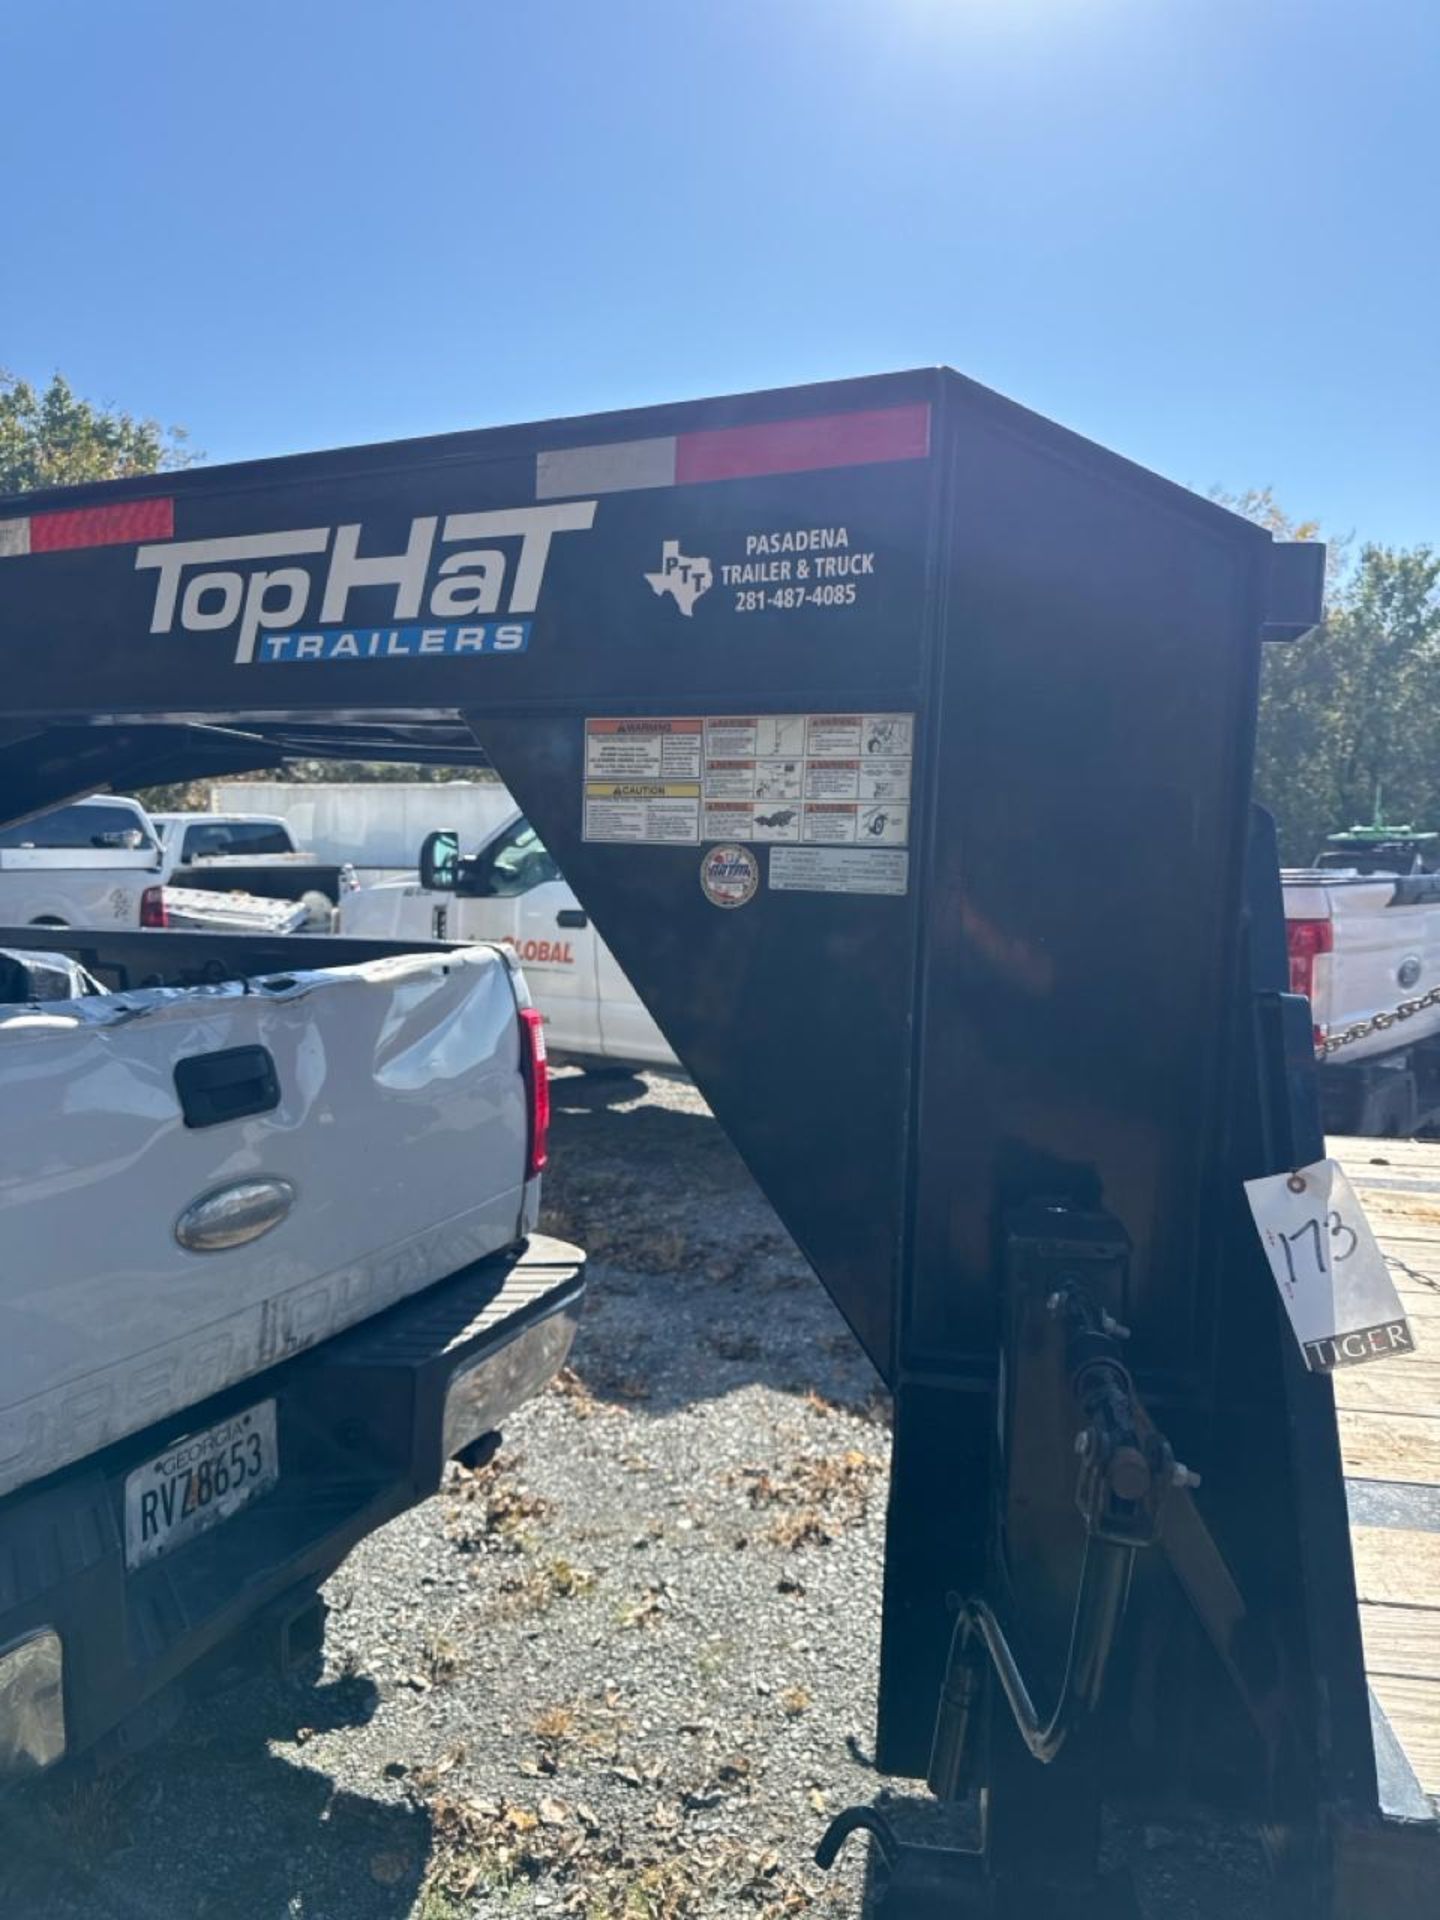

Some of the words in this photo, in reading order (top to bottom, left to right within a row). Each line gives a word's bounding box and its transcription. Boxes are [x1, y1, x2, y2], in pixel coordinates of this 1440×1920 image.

[746, 527, 849, 555] PASADENA
[664, 557, 706, 593] PTT
[721, 562, 791, 585] TRAILER
[797, 558, 810, 580] &
[815, 553, 875, 578] TRUCK
[735, 584, 857, 612] 281-487-4085
[267, 625, 525, 660] TRAILERS
[623, 786, 665, 796] CAUTION
[1277, 1210, 1358, 1283] 173
[1307, 1324, 1408, 1366] TIGER
[161, 1422, 243, 1476] GEORGIA
[141, 1432, 262, 1541] RVZ8653
